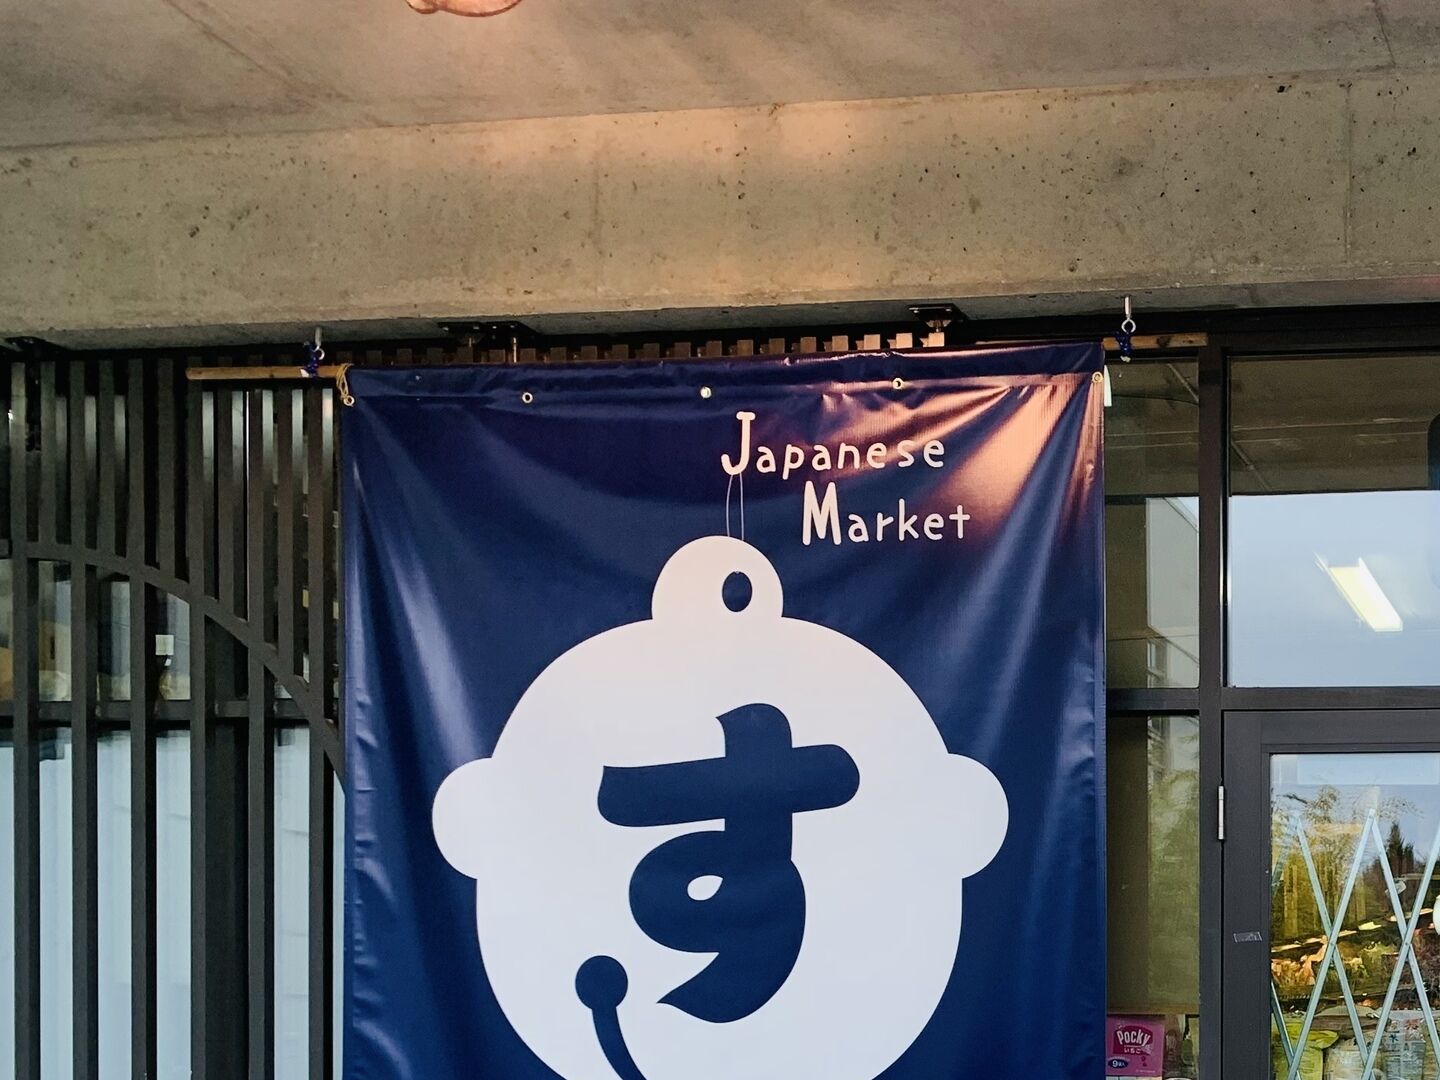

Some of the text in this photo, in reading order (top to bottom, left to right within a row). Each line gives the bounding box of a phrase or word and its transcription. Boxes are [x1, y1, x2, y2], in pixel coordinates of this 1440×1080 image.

[721, 411, 945, 480] Japanese
[802, 480, 970, 545] Market
[597, 702, 860, 1023] す
